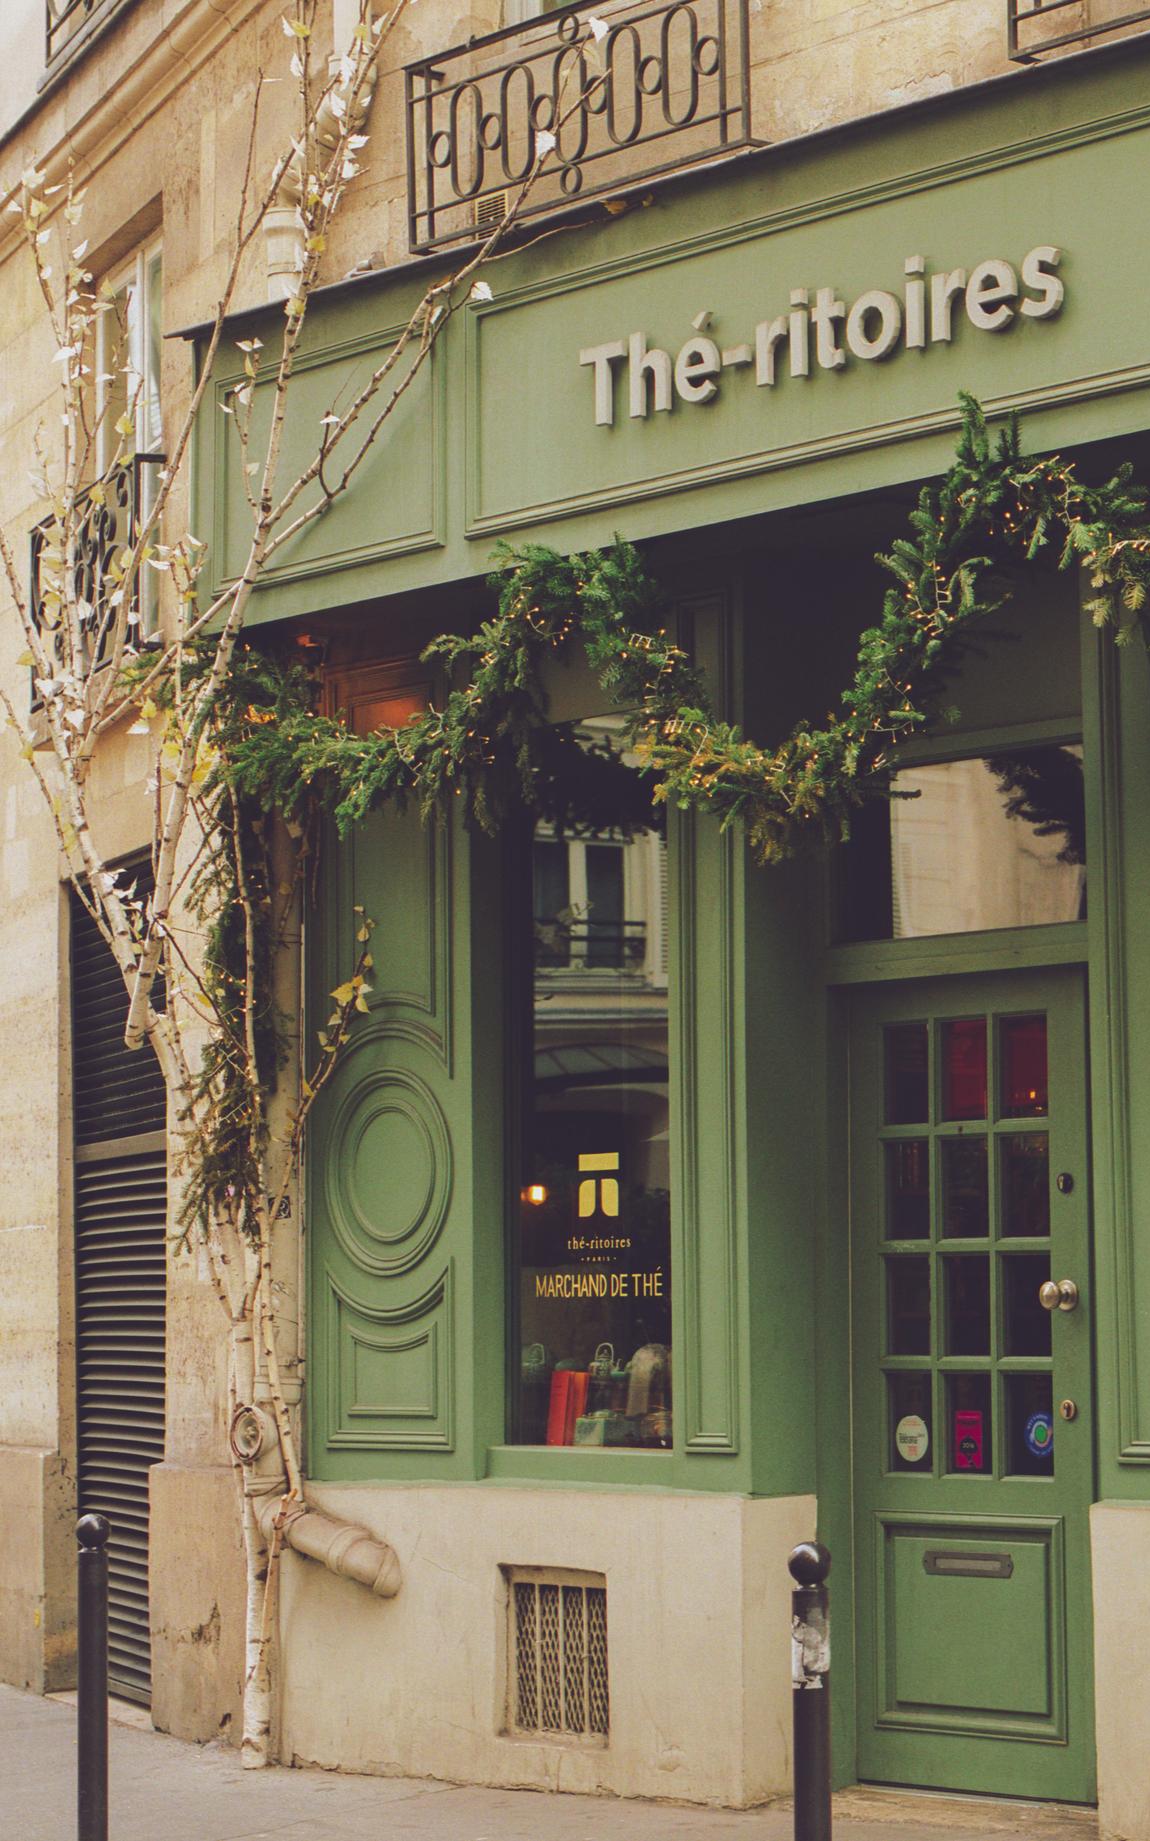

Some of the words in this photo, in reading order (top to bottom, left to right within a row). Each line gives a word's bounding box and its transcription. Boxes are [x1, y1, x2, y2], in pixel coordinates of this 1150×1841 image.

[578, 245, 1065, 426] Thé-ritoires
[567, 1235, 632, 1250] thé-ritoires
[535, 1273, 608, 1298] MARCHAND
[610, 1273, 629, 1297] DE
[631, 1265, 664, 1297] THÉ
